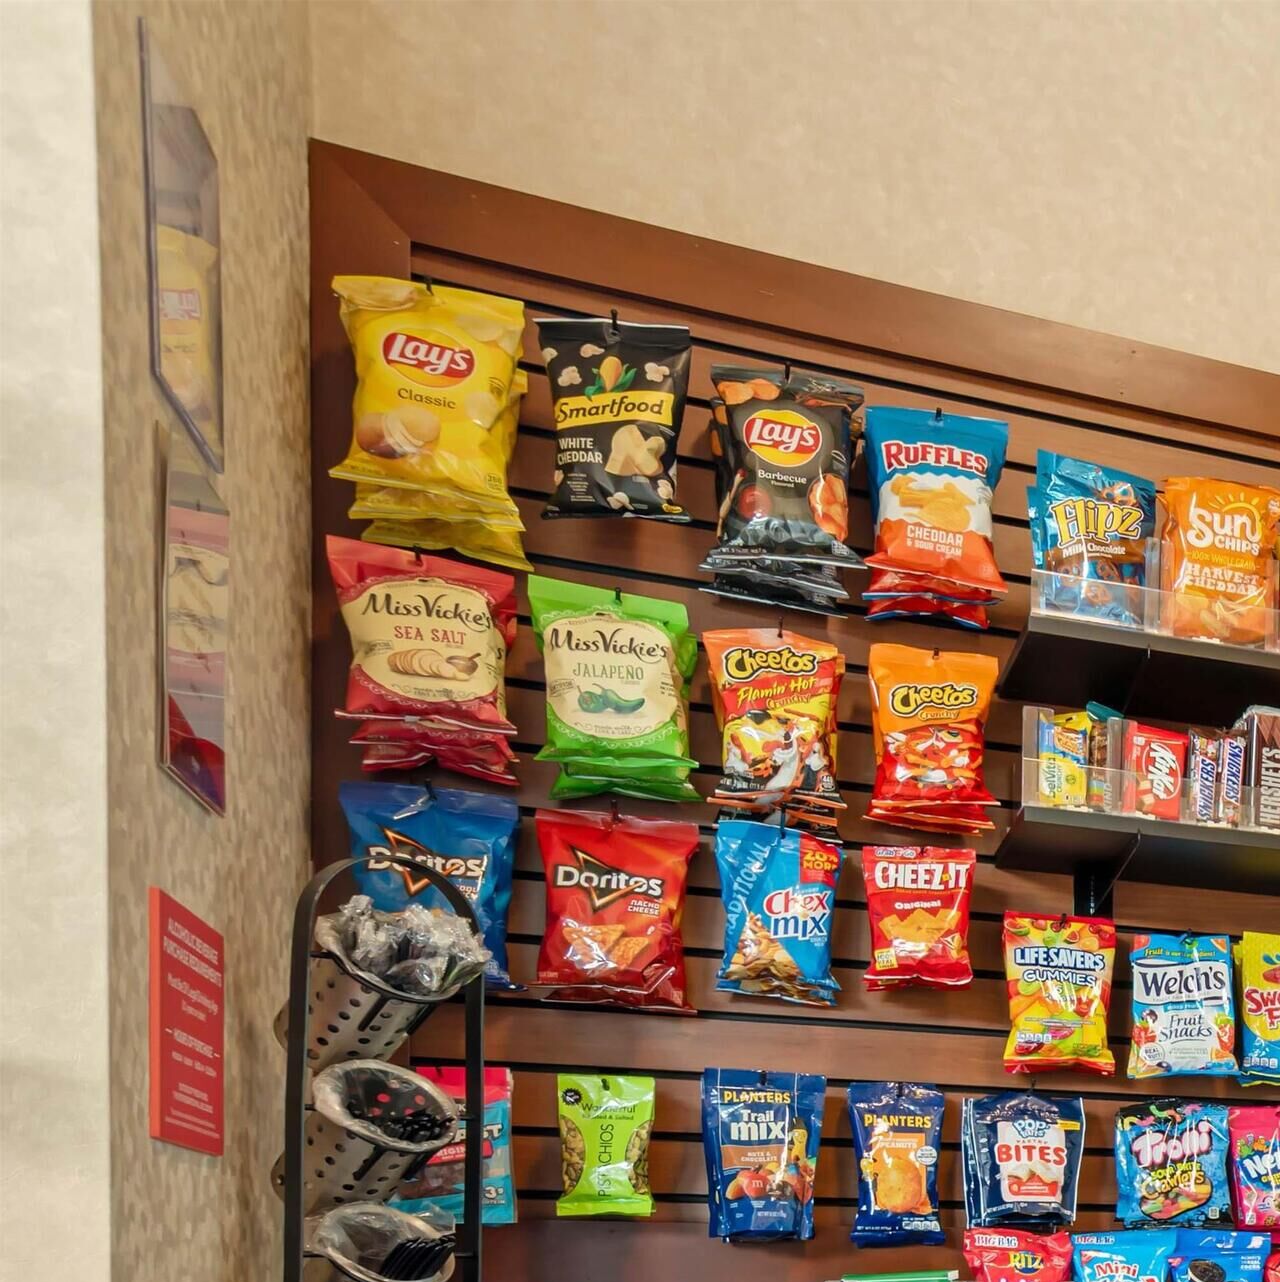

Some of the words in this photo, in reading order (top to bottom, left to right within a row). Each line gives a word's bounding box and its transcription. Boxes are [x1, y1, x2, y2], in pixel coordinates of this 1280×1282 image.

[387, 334, 471, 377] Lay's
[398, 387, 456, 411] Classic
[556, 395, 664, 423] Smartfood
[559, 437, 594, 450] WHITE
[750, 418, 818, 453] Lay's
[557, 451, 603, 465] CHEDDAR
[883, 441, 988, 474] RUFFLES
[758, 469, 807, 485] Barbecue
[1051, 497, 1143, 548] Flipz
[1187, 507, 1262, 549] Sun
[907, 525, 964, 547] CHEDDAR
[914, 539, 935, 552] SOUR
[1214, 536, 1261, 557] CHIPS
[1088, 543, 1126, 556] Chocolate
[1186, 563, 1259, 585] HARVEST
[394, 625, 424, 641] SEA
[431, 627, 466, 645] SALT
[572, 661, 645, 681] JALAPEÑO
[725, 647, 816, 679] Cheetos
[786, 676, 817, 694] Hot
[891, 684, 977, 716] Cheetos
[919, 709, 960, 721] Crunchy
[1225, 738, 1244, 804] SNICKERS
[1197, 757, 1216, 822] SNICKERS
[556, 865, 663, 897] Doritos
[627, 906, 660, 916] CHEESE
[631, 899, 660, 909] NACHO
[772, 911, 828, 939] mix
[1015, 947, 1049, 966] LIFE
[1048, 948, 1104, 970] SAVERS
[1023, 970, 1097, 988] GUMMIES
[1139, 967, 1226, 997] Welch's
[1169, 1013, 1204, 1027] Fruit
[1159, 1024, 1213, 1043] Snacks
[724, 1090, 791, 1104] PLANTERS
[740, 1109, 775, 1122] Trail
[864, 1114, 931, 1129] PLANTERS
[731, 1120, 785, 1141] mix
[997, 1144, 1067, 1165] BITES
[1131, 1122, 1212, 1168] Trolli
[974, 1234, 996, 1246] BIG
[1009, 1251, 1044, 1271] RITZ
[1094, 1262, 1138, 1278] Mini
